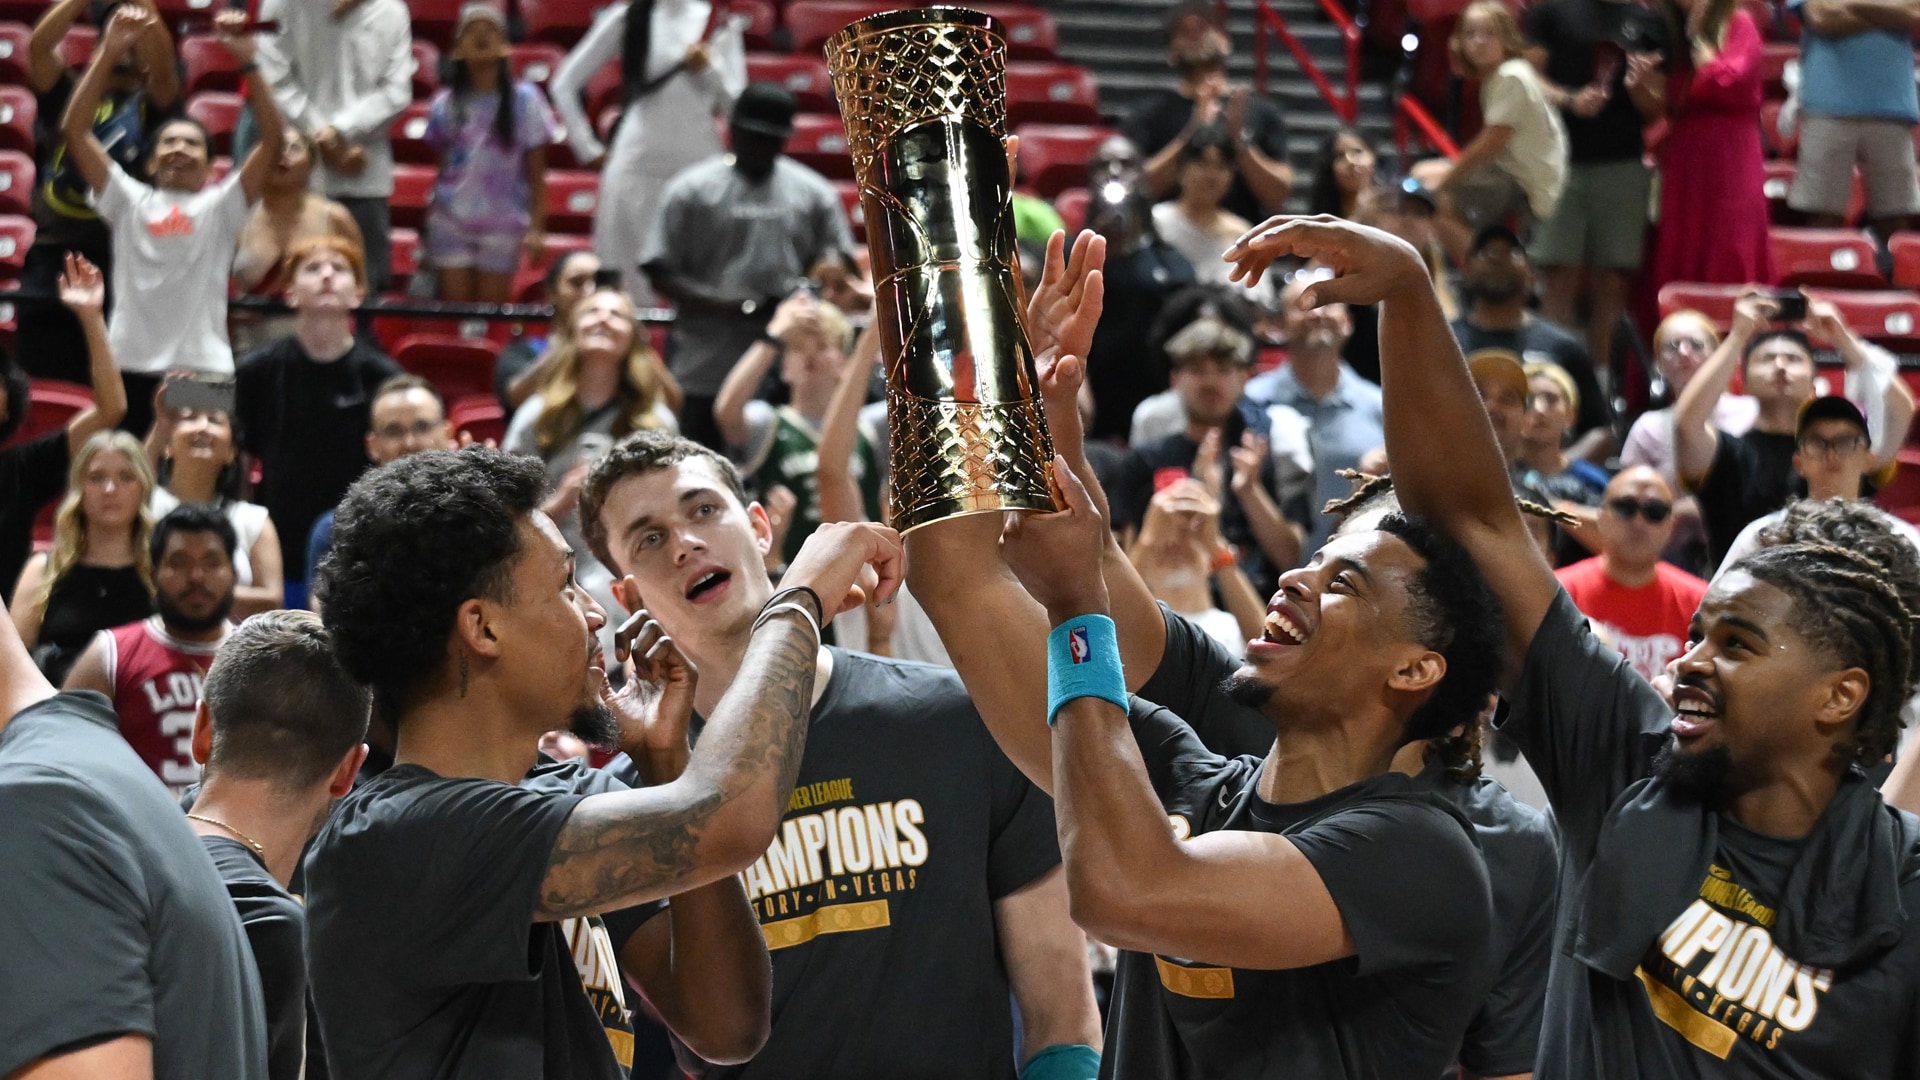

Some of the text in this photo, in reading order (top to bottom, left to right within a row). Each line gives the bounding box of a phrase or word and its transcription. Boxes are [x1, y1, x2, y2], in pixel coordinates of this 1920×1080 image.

[785, 777, 855, 813] MER LEAGUE
[737, 798, 929, 899] AMPIONS
[852, 868, 917, 897] VEGAS
[1707, 993, 1784, 1050] VEGAS
